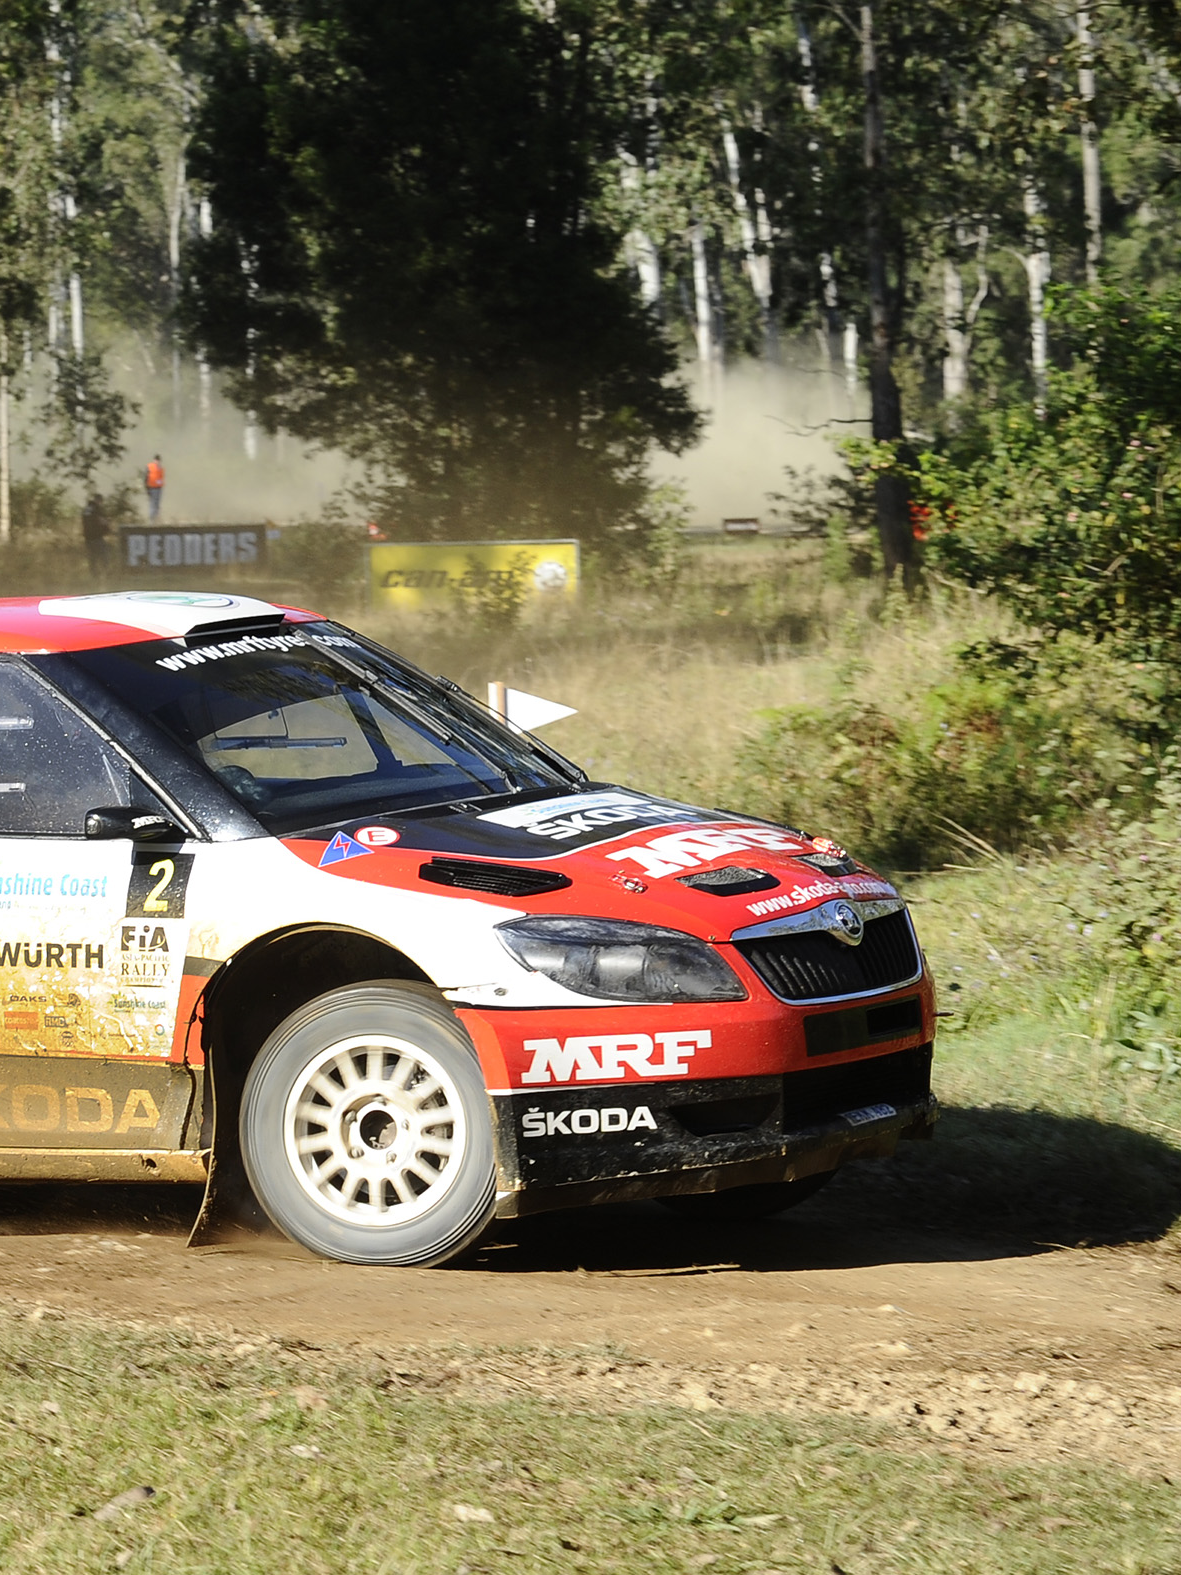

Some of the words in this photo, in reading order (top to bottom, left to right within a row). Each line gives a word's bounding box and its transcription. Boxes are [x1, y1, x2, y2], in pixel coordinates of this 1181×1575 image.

[127, 532, 257, 566] PEDDERS
[155, 635, 361, 672] www.mrftyrecom
[367, 830, 388, 842] E
[605, 827, 804, 879] MRF
[60, 873, 107, 897] Coast
[143, 858, 175, 912] 2
[121, 963, 170, 977] RALLY
[10, 994, 47, 1003] OAKS
[521, 1029, 712, 1083] MRF
[522, 1107, 658, 1138] ŠKODA
